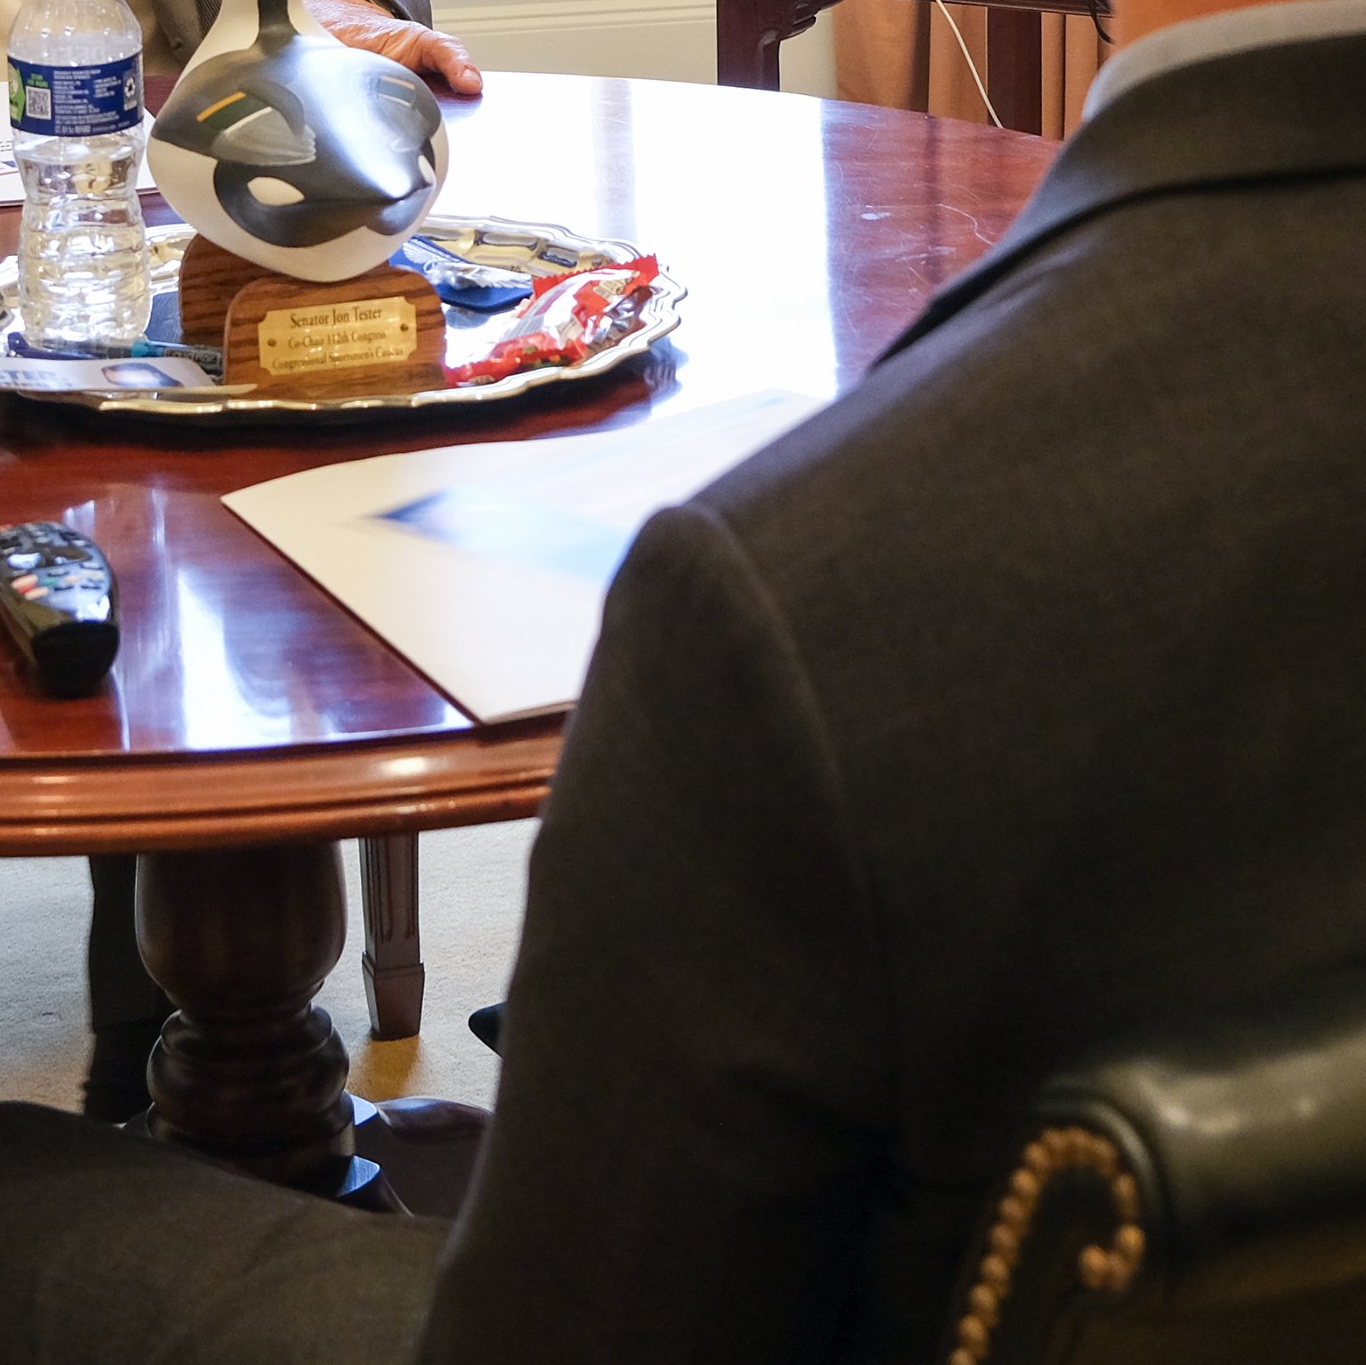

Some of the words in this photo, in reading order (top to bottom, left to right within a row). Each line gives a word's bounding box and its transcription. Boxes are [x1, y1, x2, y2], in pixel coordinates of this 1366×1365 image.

[290, 312, 329, 329] Senator
[332, 308, 350, 326] Jon
[353, 306, 382, 322] Tester
[289, 334, 324, 350] Co-Chair
[352, 330, 387, 345] Congress
[272, 354, 327, 372] Congressional
